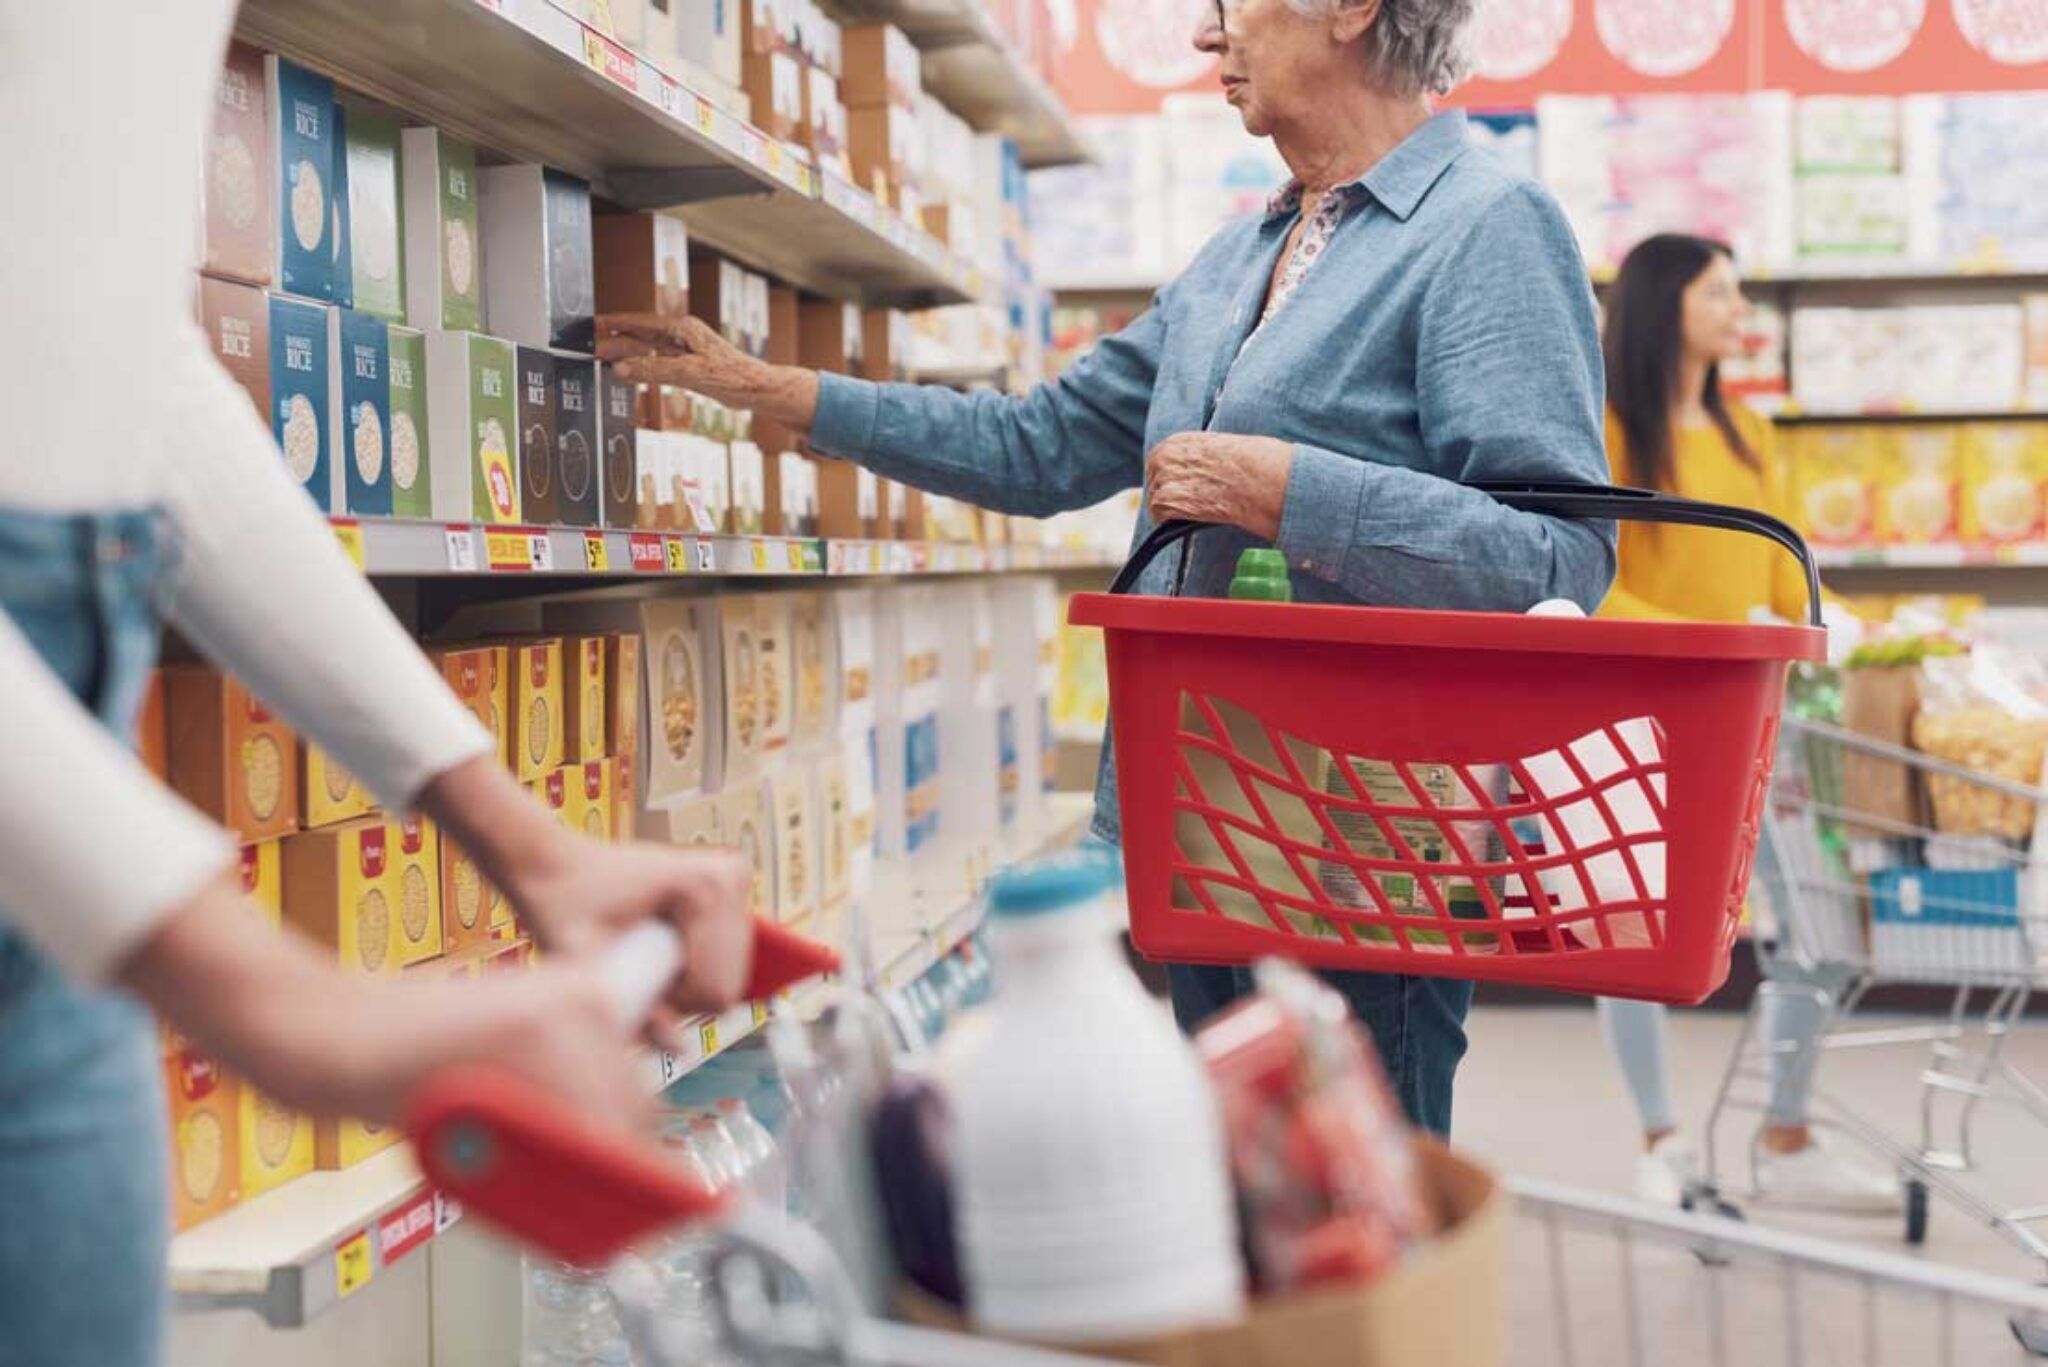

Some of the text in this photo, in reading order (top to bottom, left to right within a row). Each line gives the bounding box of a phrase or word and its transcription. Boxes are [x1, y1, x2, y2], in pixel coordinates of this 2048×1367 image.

[295, 111, 320, 140] RICE
[221, 331, 252, 358] RICE
[286, 347, 313, 372] RICE
[355, 356, 377, 380] RICE
[528, 384, 546, 406] RICE
[562, 392, 583, 413] RICE
